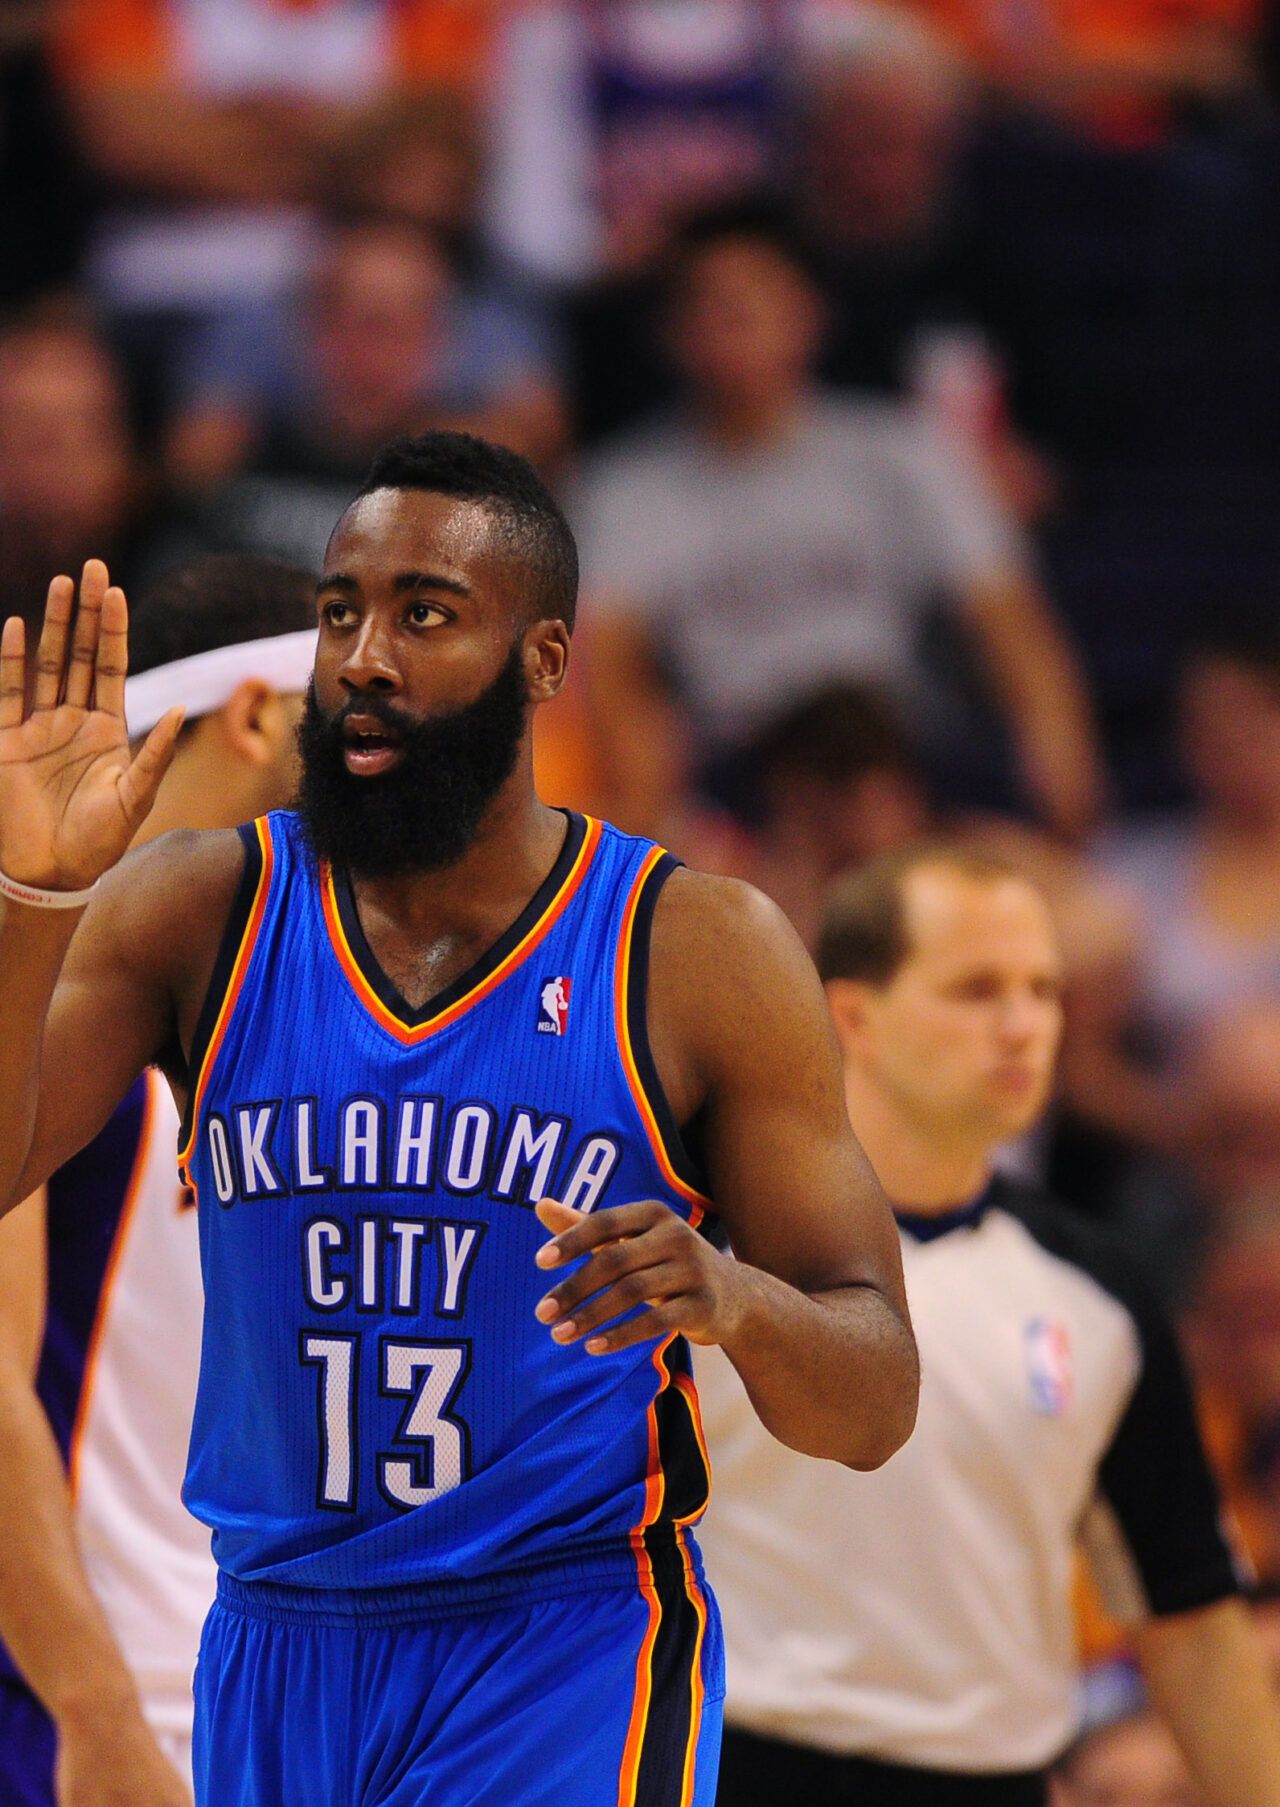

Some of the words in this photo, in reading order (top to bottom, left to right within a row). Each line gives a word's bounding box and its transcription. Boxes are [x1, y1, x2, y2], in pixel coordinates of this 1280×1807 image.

[537, 1021, 557, 1033] NBA
[207, 1097, 620, 1213] OKLAHOMA
[304, 1218, 483, 1315] CITY
[303, 1333, 468, 1510] 13
